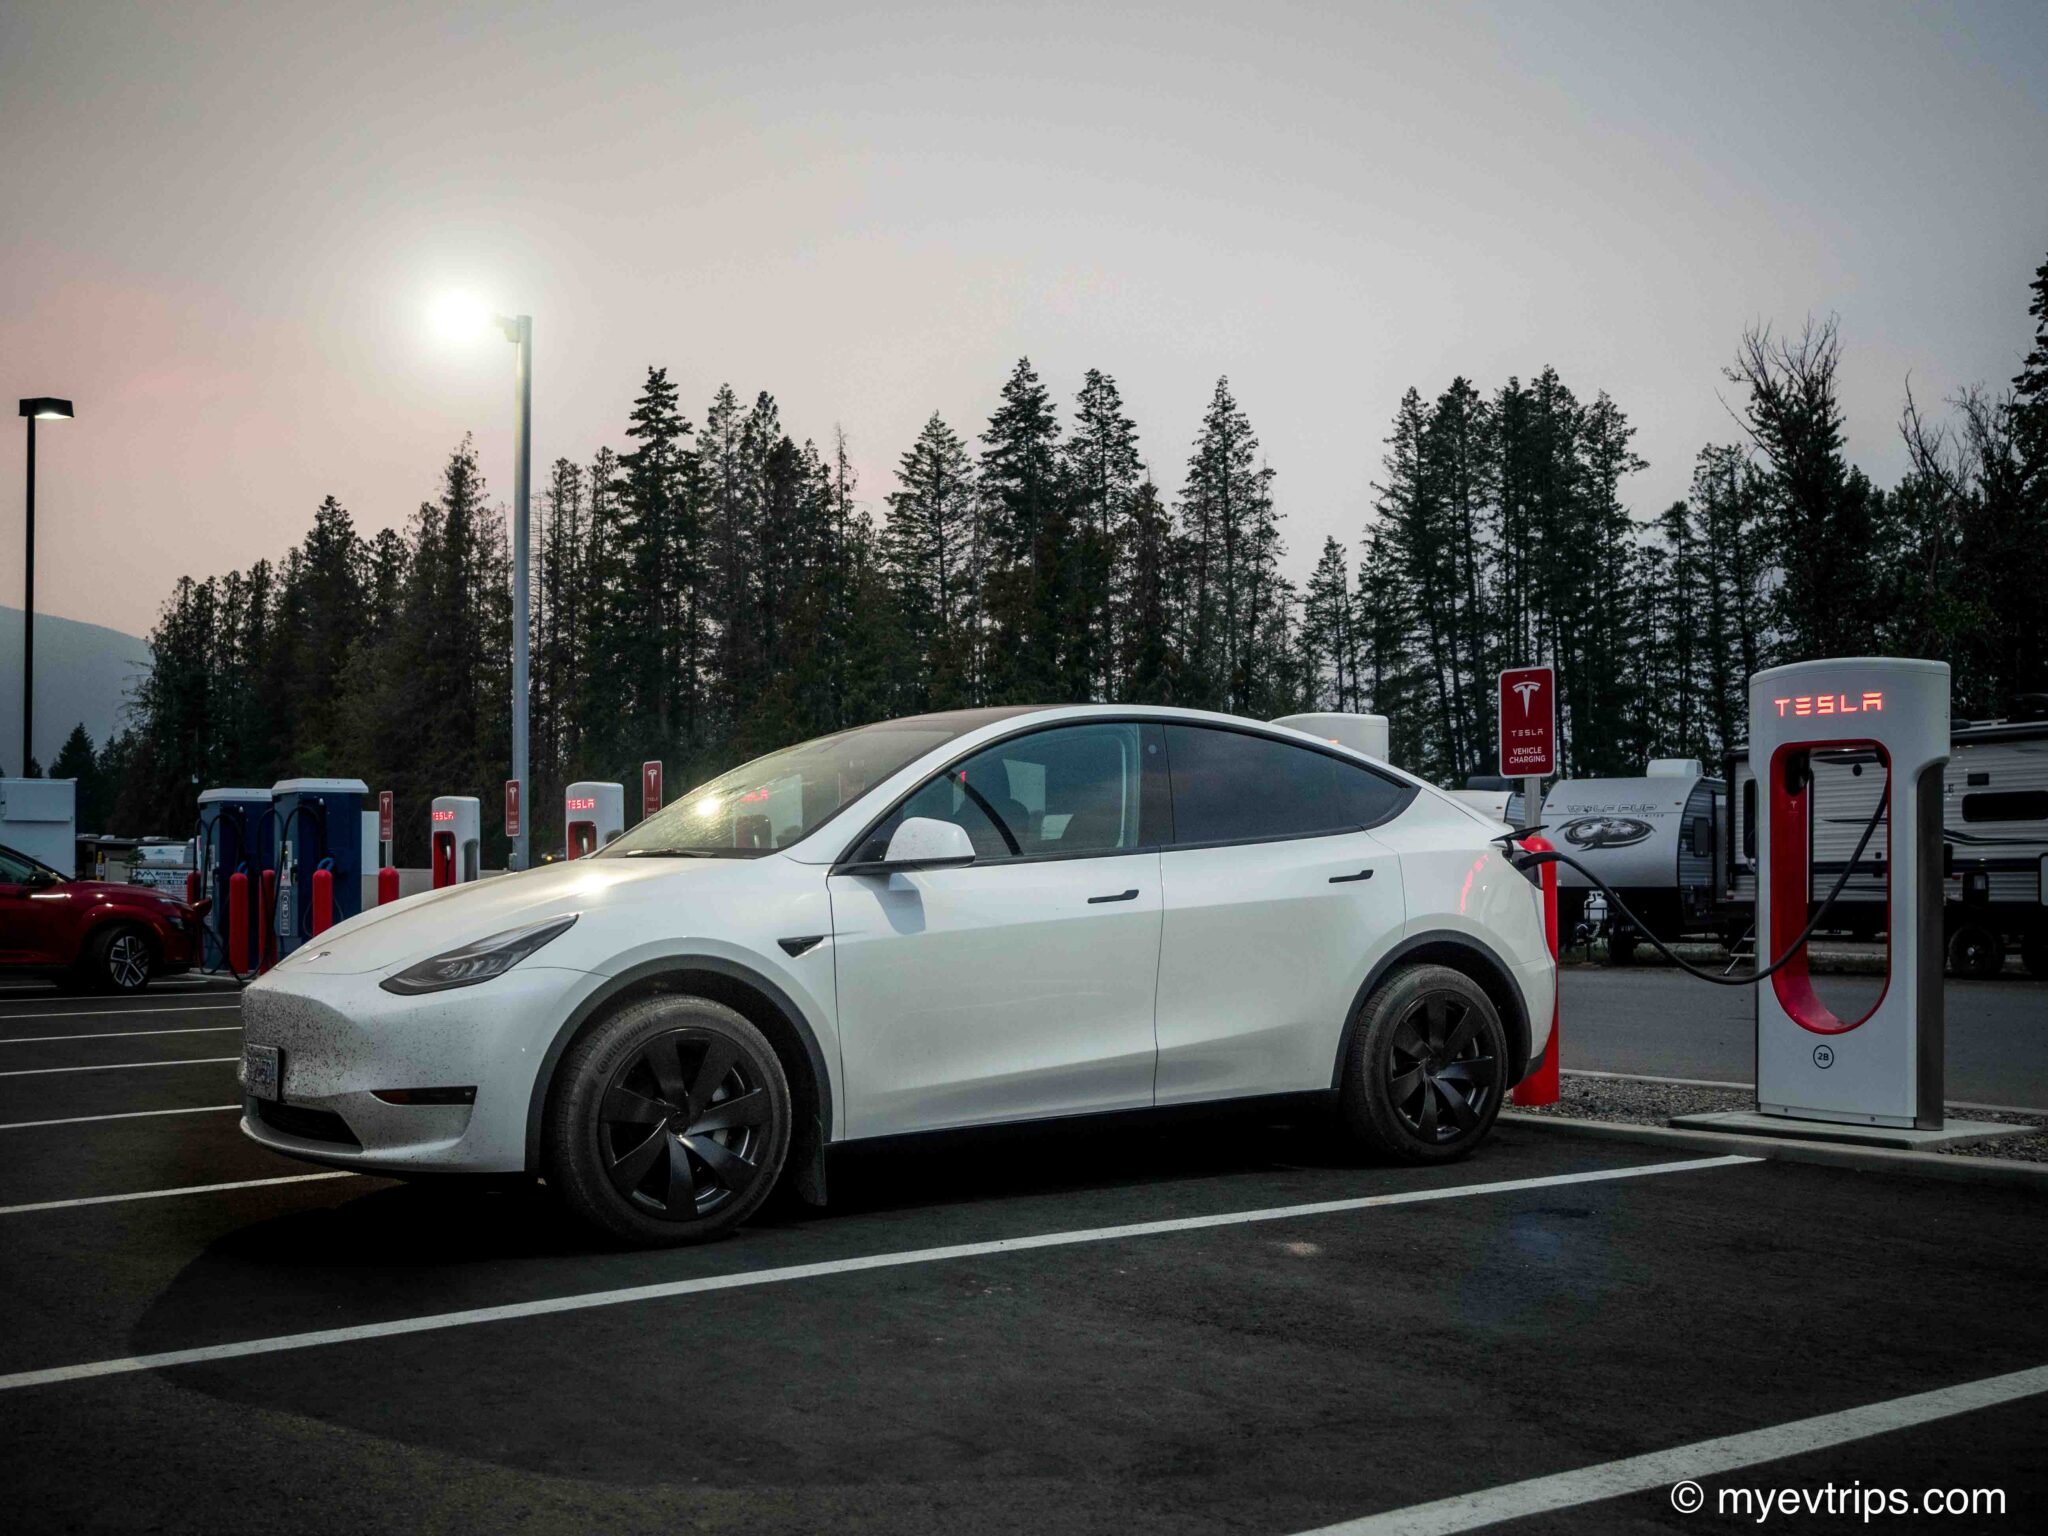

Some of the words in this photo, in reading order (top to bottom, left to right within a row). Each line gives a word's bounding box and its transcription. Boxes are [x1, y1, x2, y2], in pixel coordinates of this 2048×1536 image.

[1774, 691, 1883, 717] TESLA
[1513, 747, 1542, 755] VEHICLE
[1509, 755, 1546, 764] CHARGING
[568, 799, 595, 809] TESLA
[432, 811, 454, 820] TESLA
[1817, 1052, 1829, 1061] 2B
